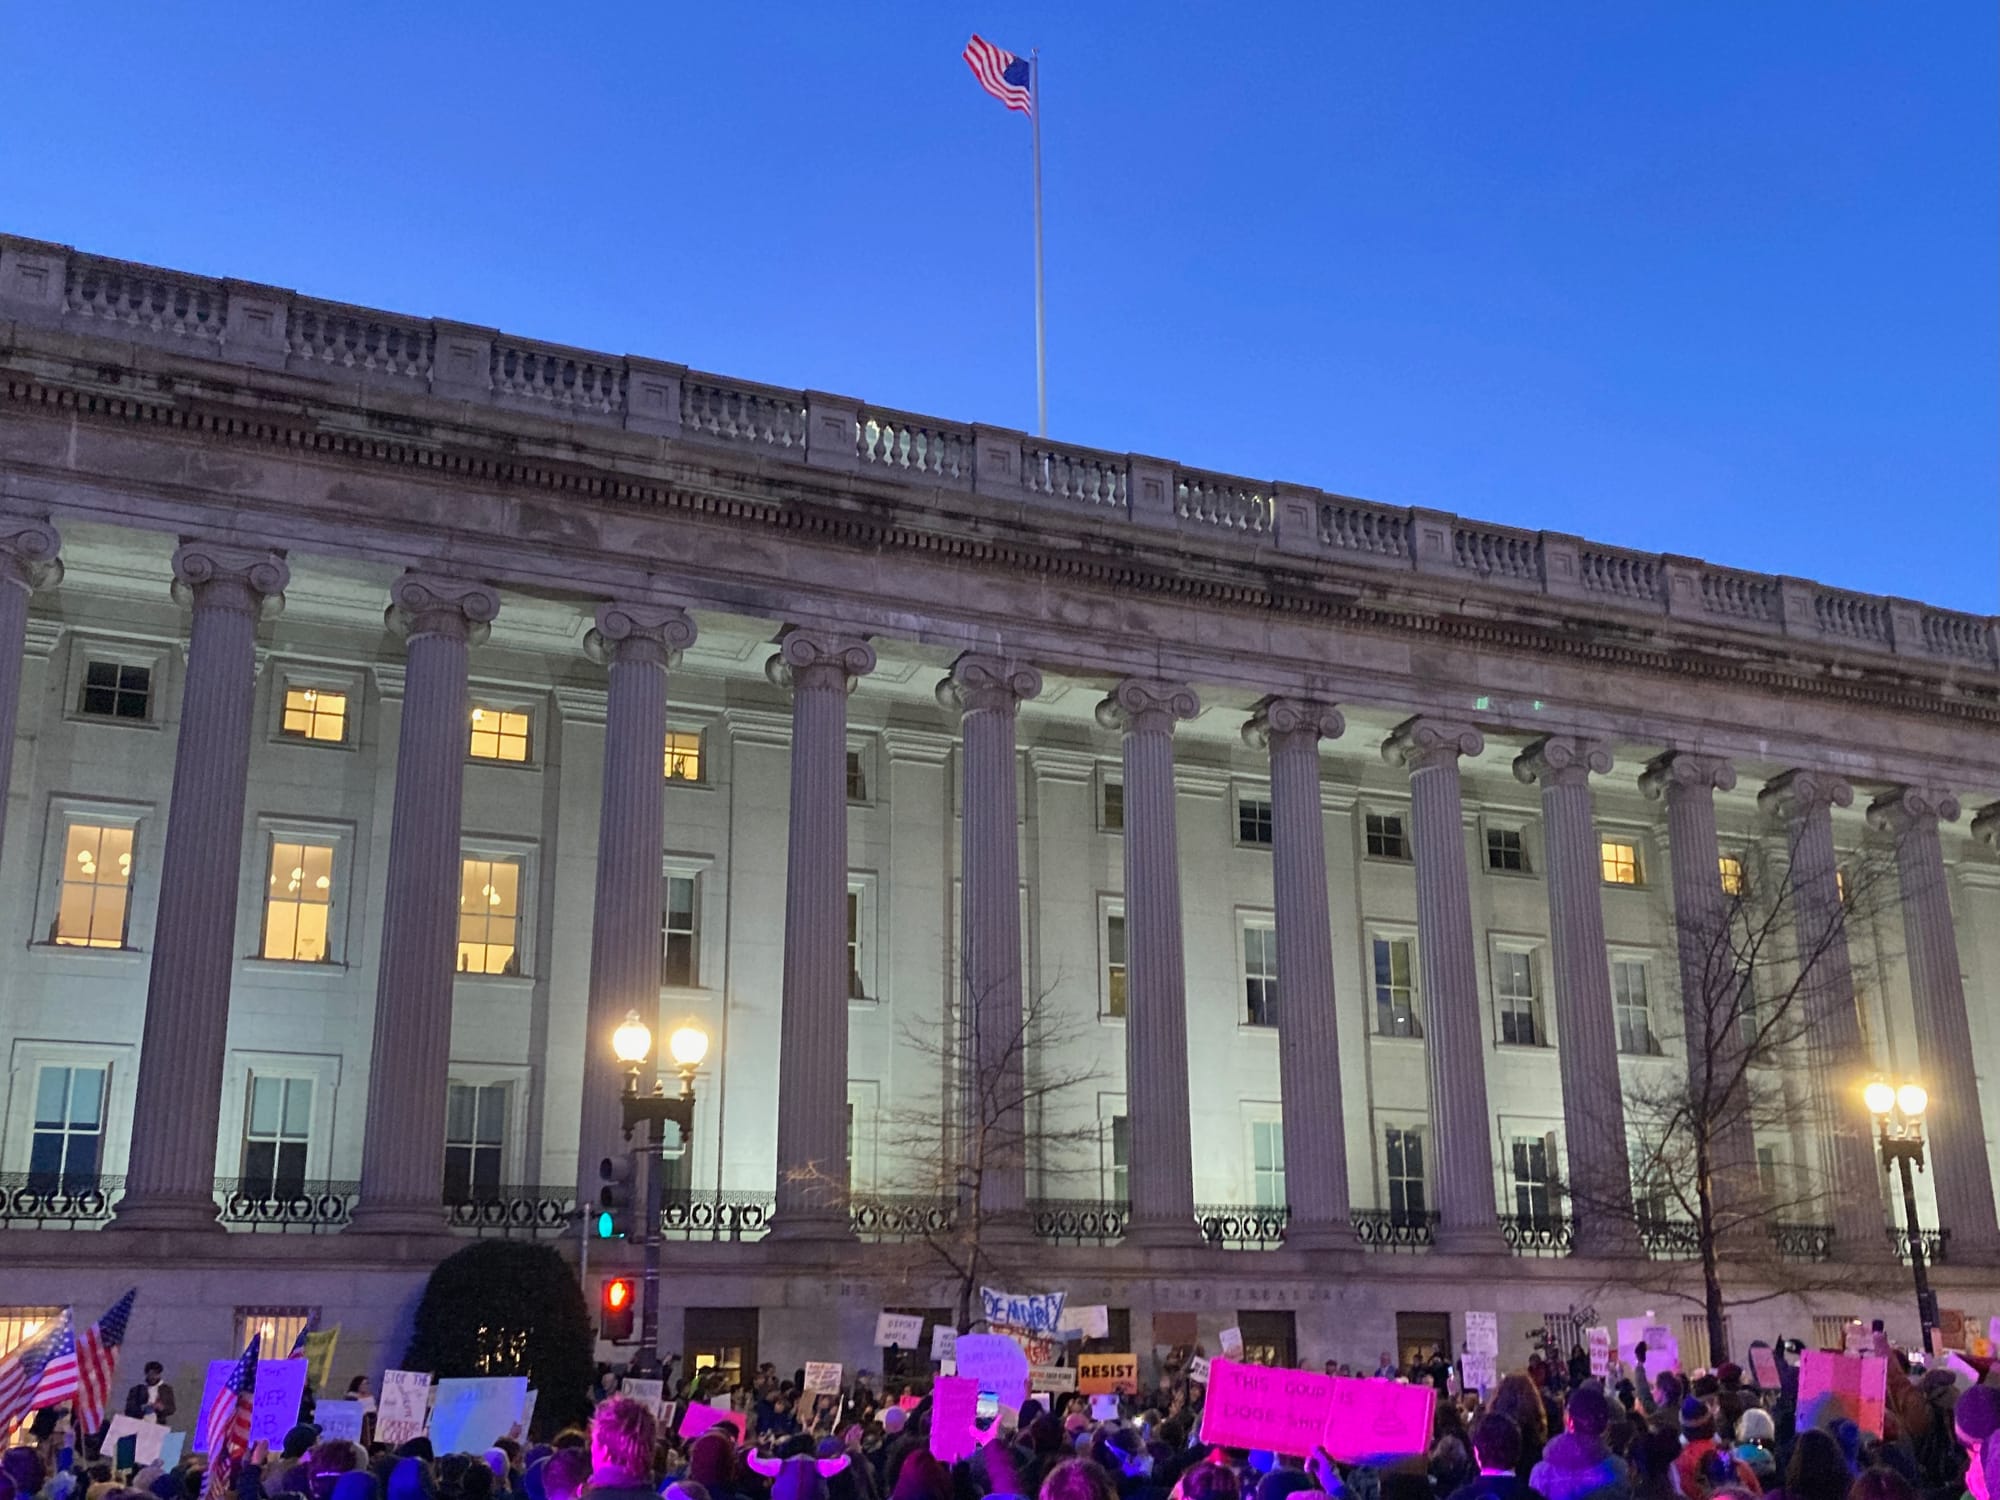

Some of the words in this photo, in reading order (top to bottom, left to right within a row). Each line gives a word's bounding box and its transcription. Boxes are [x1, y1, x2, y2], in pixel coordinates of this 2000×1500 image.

[983, 1289, 1065, 1334] DEMOCRACY
[384, 1371, 407, 1385] STOP
[414, 1373, 429, 1387] THE
[1081, 1364, 1134, 1379] RESIST
[1229, 1370, 1269, 1393] THIS
